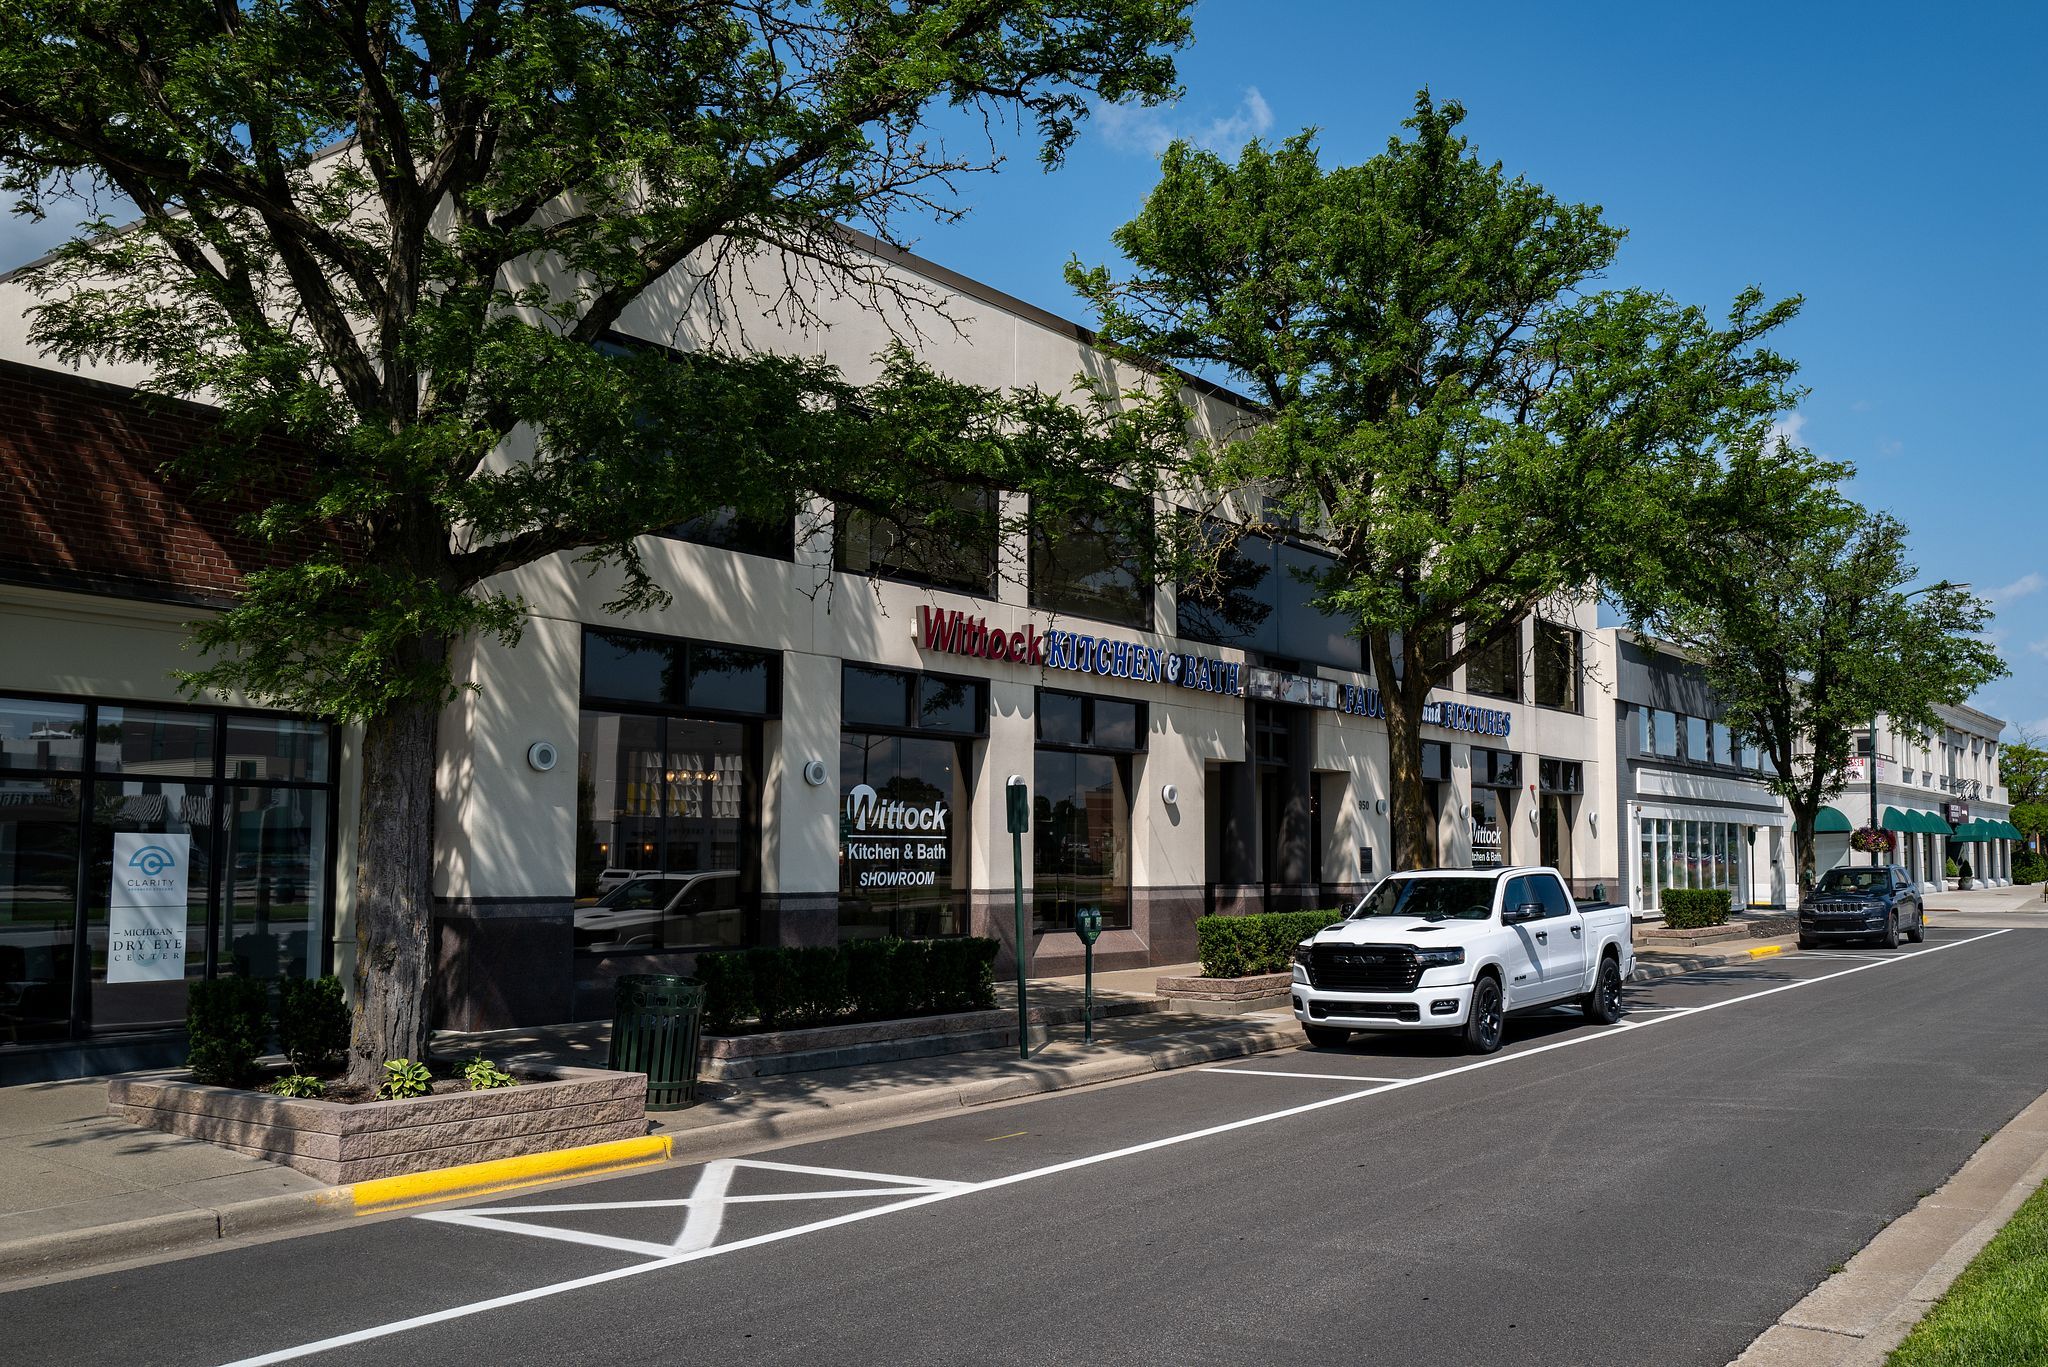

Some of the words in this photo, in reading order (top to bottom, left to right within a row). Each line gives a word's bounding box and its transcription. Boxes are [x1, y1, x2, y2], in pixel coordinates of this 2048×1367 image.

[922, 604, 1043, 666] Wittock
[1049, 629, 1164, 683] KITCHEN
[1166, 652, 1181, 684] &
[1182, 653, 1240, 695] BATH
[1443, 701, 1511, 738] FIXTURES
[846, 784, 948, 831] Wittock
[1358, 801, 1370, 811] 950
[848, 843, 900, 860] Kitchen
[903, 843, 914, 860] &
[917, 843, 946, 860] Bath
[1472, 851, 1486, 862] tchen
[1486, 852, 1491, 862] &
[1491, 852, 1502, 862] Bath
[127, 879, 175, 887] CLARITY
[860, 871, 935, 887] SHOWROOM
[124, 928, 173, 937] MICHIGAN
[113, 940, 146, 951] DRY
[154, 939, 182, 950] EYE
[114, 952, 180, 962] CENTER
